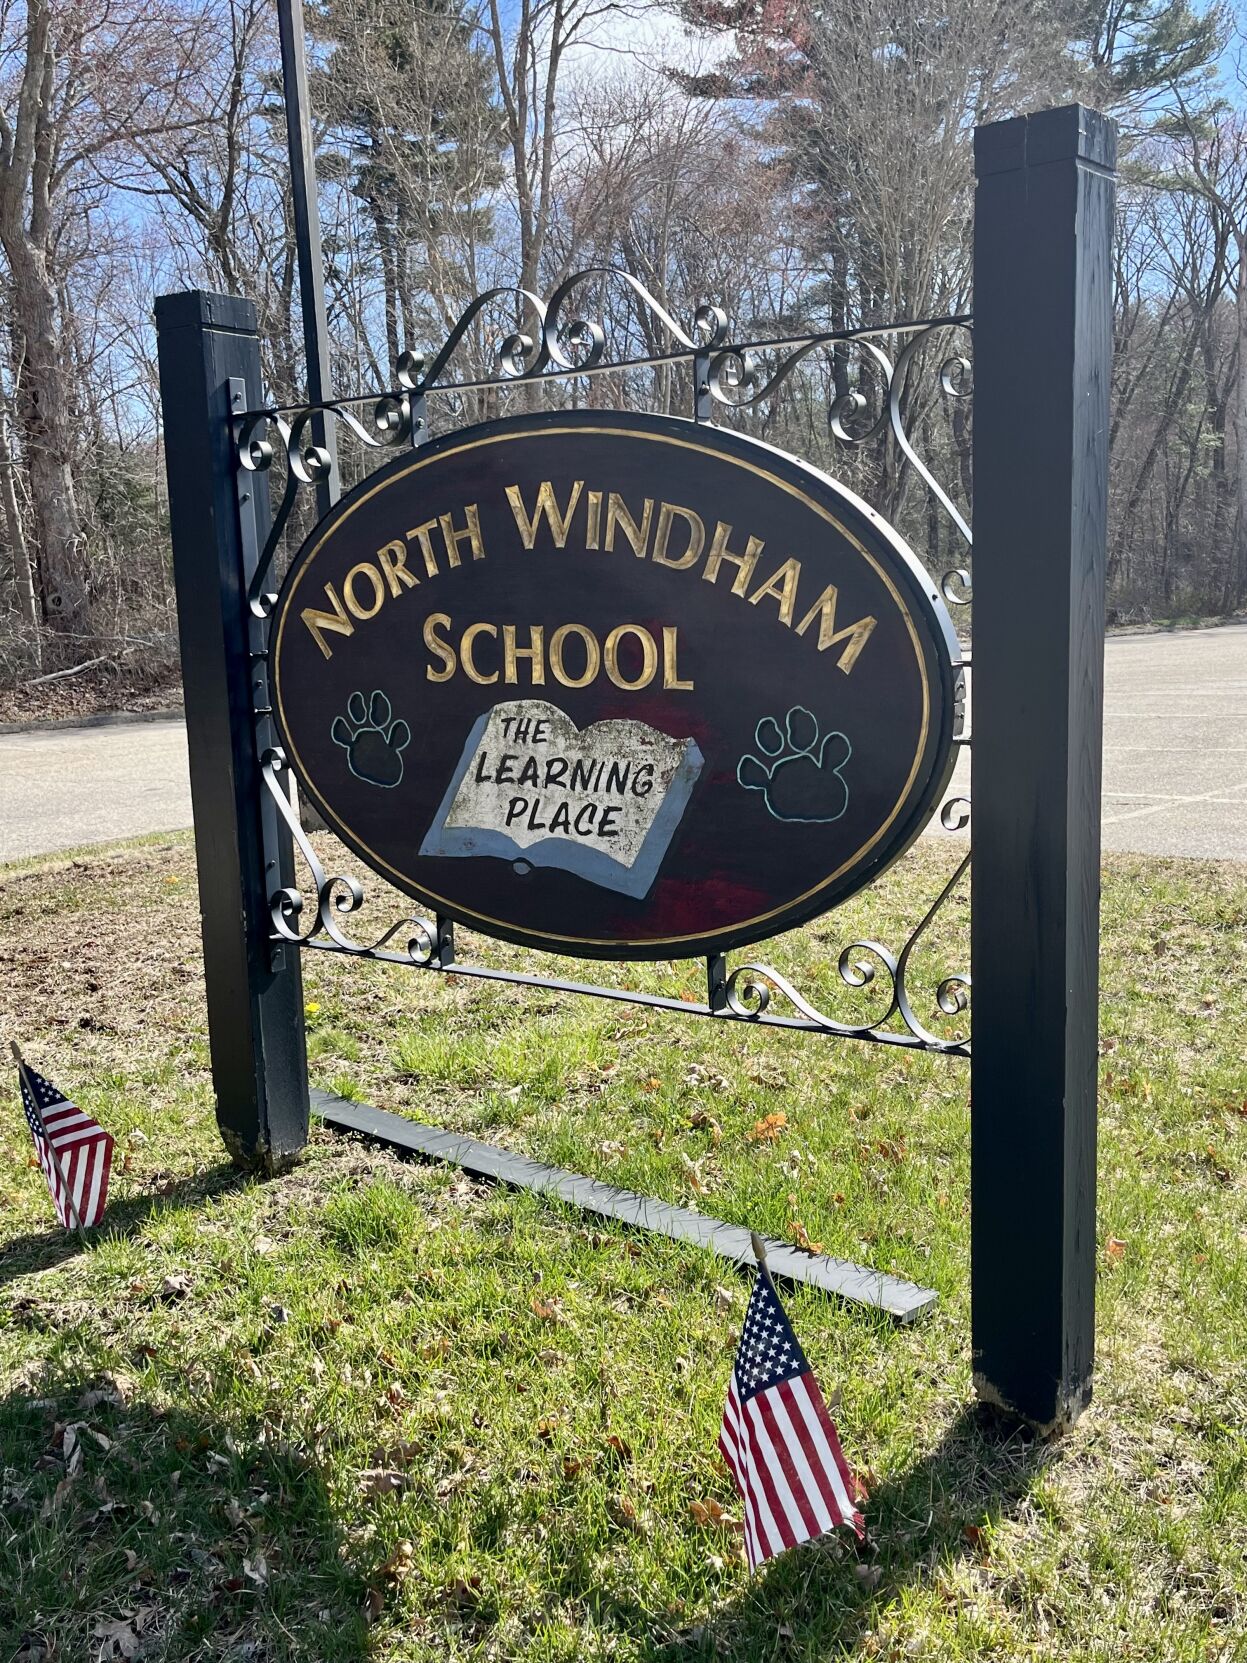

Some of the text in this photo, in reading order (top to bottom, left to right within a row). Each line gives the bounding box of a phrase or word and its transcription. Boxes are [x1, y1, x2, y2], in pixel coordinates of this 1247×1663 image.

[300, 480, 878, 675] NORTH WINDHAM
[423, 612, 694, 690] SCHOOL
[501, 717, 550, 744] THE
[475, 752, 655, 797] LEARNING
[505, 798, 622, 837] PLACE
